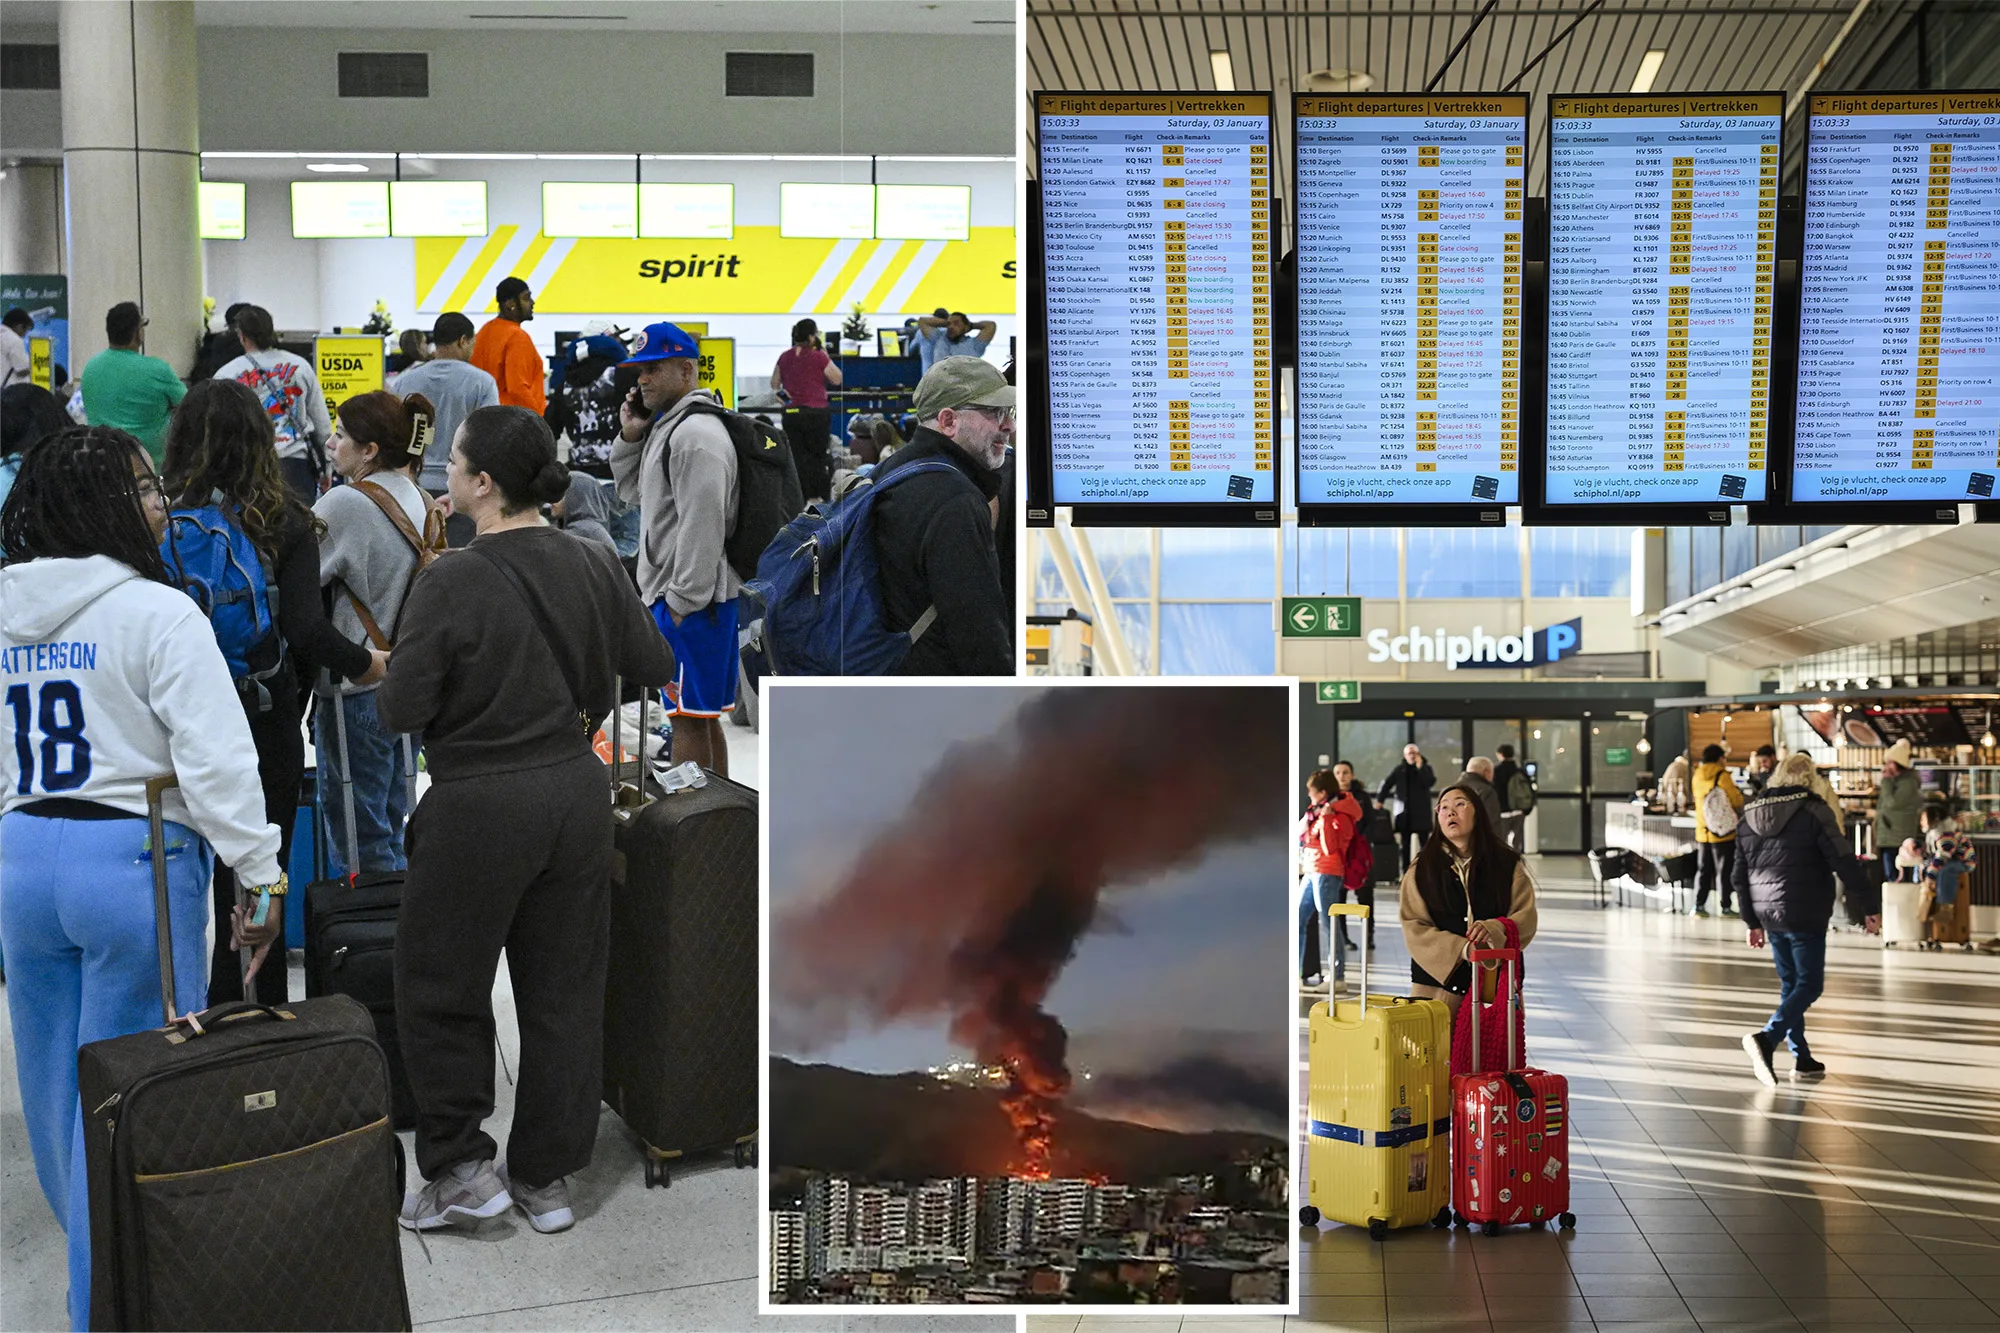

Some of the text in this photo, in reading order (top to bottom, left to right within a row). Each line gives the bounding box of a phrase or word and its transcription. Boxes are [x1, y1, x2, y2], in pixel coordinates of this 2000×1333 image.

[1061, 100, 1245, 116] Flight departures Vertrekken
[1318, 102, 1502, 117] Flight departures Vertrekken
[1574, 101, 1758, 117] Flight departures Vertrekken
[1832, 100, 1868, 113] Flight
[1871, 99, 1938, 112] departures
[1042, 119, 1262, 128] 15:03:33 Saturday, 03 January
[1299, 120, 1519, 130] 15:03:33 Saturday, 03 January
[1554, 120, 1775, 130] 15:03:33 Saturday, 03 January
[1812, 117, 1995, 127] 15:03:33 Saturday, 03
[1125, 134, 1143, 142] Flight
[1381, 135, 1399, 143] Flight
[1636, 136, 1654, 144] Flight
[1206, 147, 1215, 155] go
[1226, 147, 1240, 155] gate
[1185, 179, 1212, 187] Delayed
[1694, 191, 1720, 199] Delayed
[1440, 202, 1462, 210] Priority
[1946, 252, 1972, 260] Delayed
[639, 255, 740, 283] spirit
[322, 358, 363, 371] USDA
[698, 355, 714, 370] ag
[698, 372, 715, 382] rop
[322, 382, 347, 390] USDA
[1815, 432, 1832, 440] Cape
[1081, 478, 1099, 487] Volg
[1101, 478, 1109, 487] je
[1142, 477, 1166, 485] check
[1190, 479, 1206, 487] app
[1327, 478, 1345, 487] Volg
[1347, 478, 1355, 487] je
[1387, 478, 1411, 486] check
[1435, 479, 1451, 487] app
[1574, 478, 1592, 488] Volg
[1594, 478, 1602, 488] je
[1634, 477, 1658, 486] check
[1682, 478, 1698, 486] app
[1821, 476, 1839, 486] Volg
[1842, 476, 1849, 486] je
[1881, 475, 1906, 484] check
[1931, 476, 1947, 485] app
[1081, 489, 1149, 498] schiphol.nl/app
[1327, 489, 1394, 498] schiphol.nl/app
[1574, 489, 1641, 498] schiphol.nl/app
[1820, 487, 1888, 497] schiphol.nl/app
[1367, 625, 1576, 671] Schiphol P
[5, 679, 92, 795] 18
